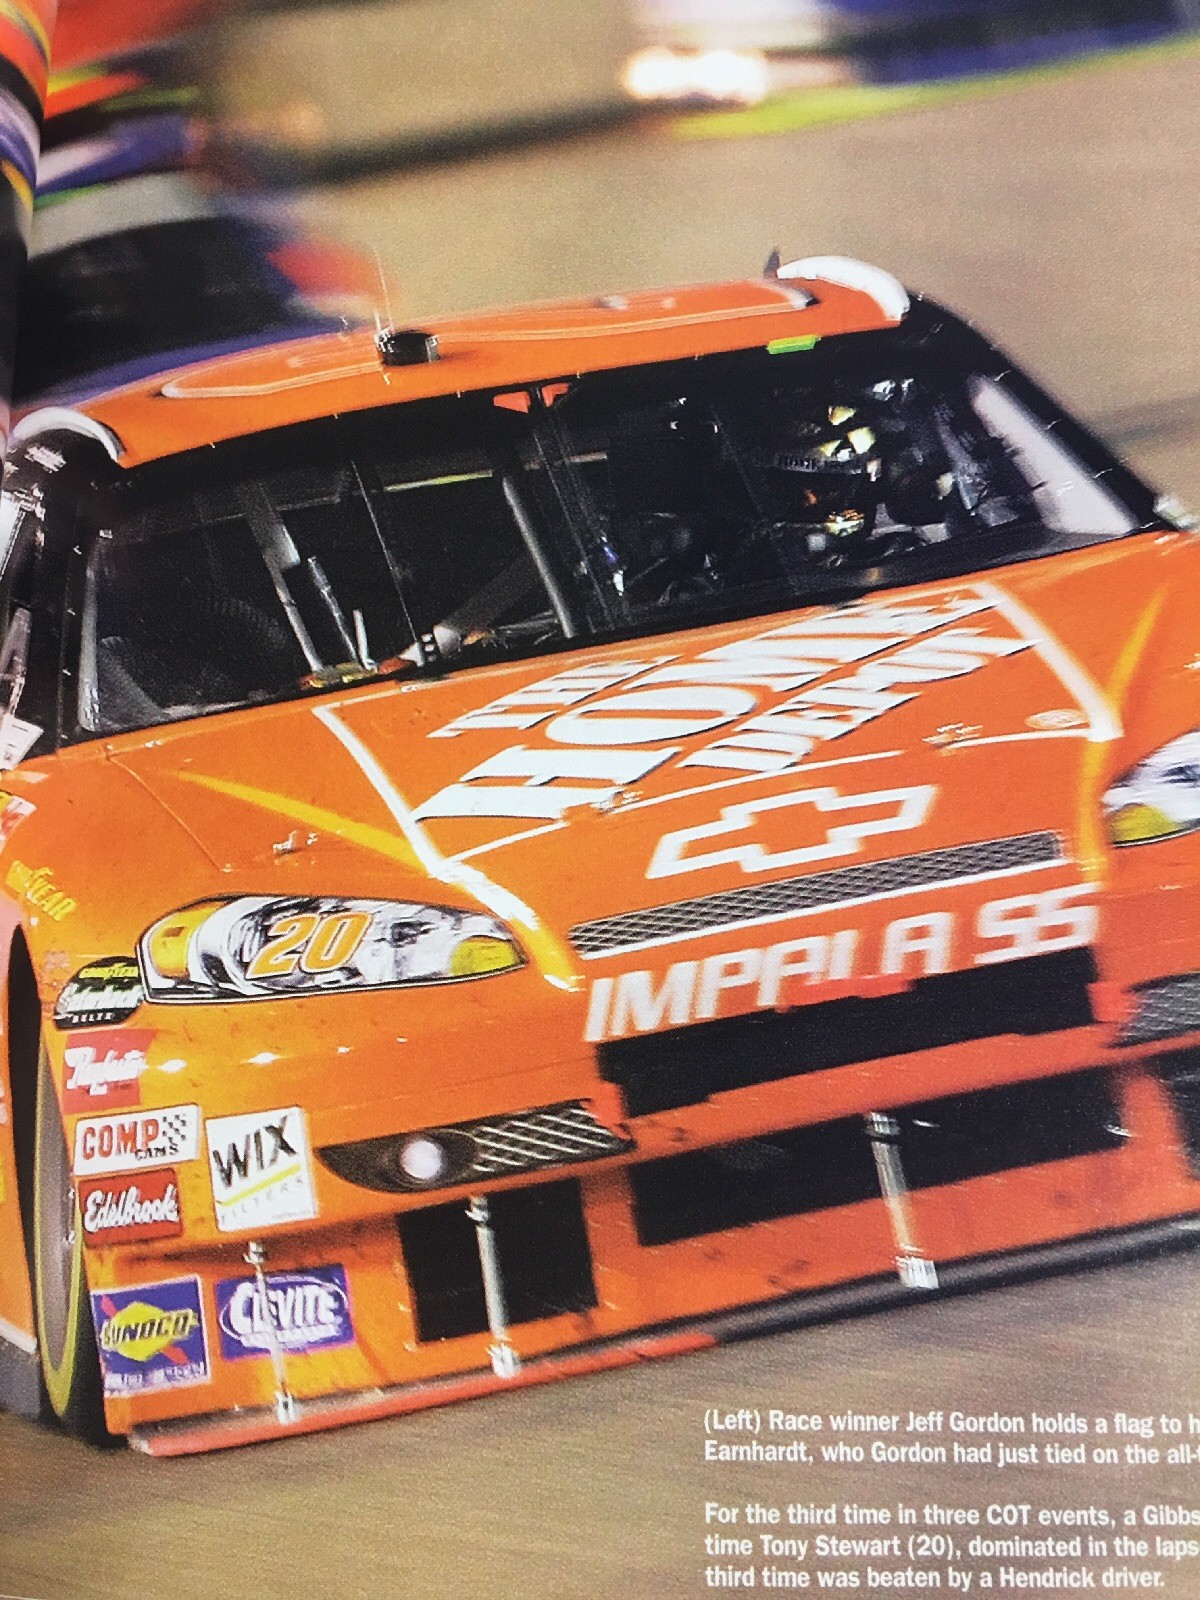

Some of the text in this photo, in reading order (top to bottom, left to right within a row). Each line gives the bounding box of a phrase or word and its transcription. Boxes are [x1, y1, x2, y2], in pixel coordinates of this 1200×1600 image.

[246, 911, 374, 980] 20
[82, 1117, 160, 1160] COMP
[212, 1114, 298, 1189] WIX
[100, 1308, 198, 1352] SUNOCO
[703, 1408, 761, 1435] (Left)
[768, 1410, 823, 1432] Race
[828, 1409, 900, 1433] winner
[905, 1410, 944, 1433] Jeff
[949, 1411, 1026, 1434] Gordon
[1031, 1412, 1089, 1434] holds
[1094, 1417, 1109, 1434] a
[1113, 1411, 1155, 1439] flag
[1160, 1413, 1182, 1434] to
[704, 1439, 814, 1466] Earnhardt,
[820, 1441, 865, 1463] who
[870, 1440, 947, 1463] Gordon
[953, 1441, 993, 1464] had
[997, 1441, 1040, 1466] just
[1043, 1442, 1087, 1464] tied
[1092, 1447, 1120, 1464] on
[1123, 1443, 1161, 1464] the
[705, 1501, 739, 1524] For
[744, 1503, 781, 1525] the
[786, 1503, 837, 1525] third
[842, 1503, 892, 1525] time
[898, 1503, 917, 1525] in
[922, 1503, 980, 1525] three
[986, 1503, 1032, 1526] COT
[1038, 1505, 1116, 1530] events,
[1123, 1509, 1137, 1526] a
[704, 1533, 1200, 1561] time Tony Stewart (20), dominated in the laps
[704, 1564, 1166, 1593] third time was beaten by a Hendrick driver.
